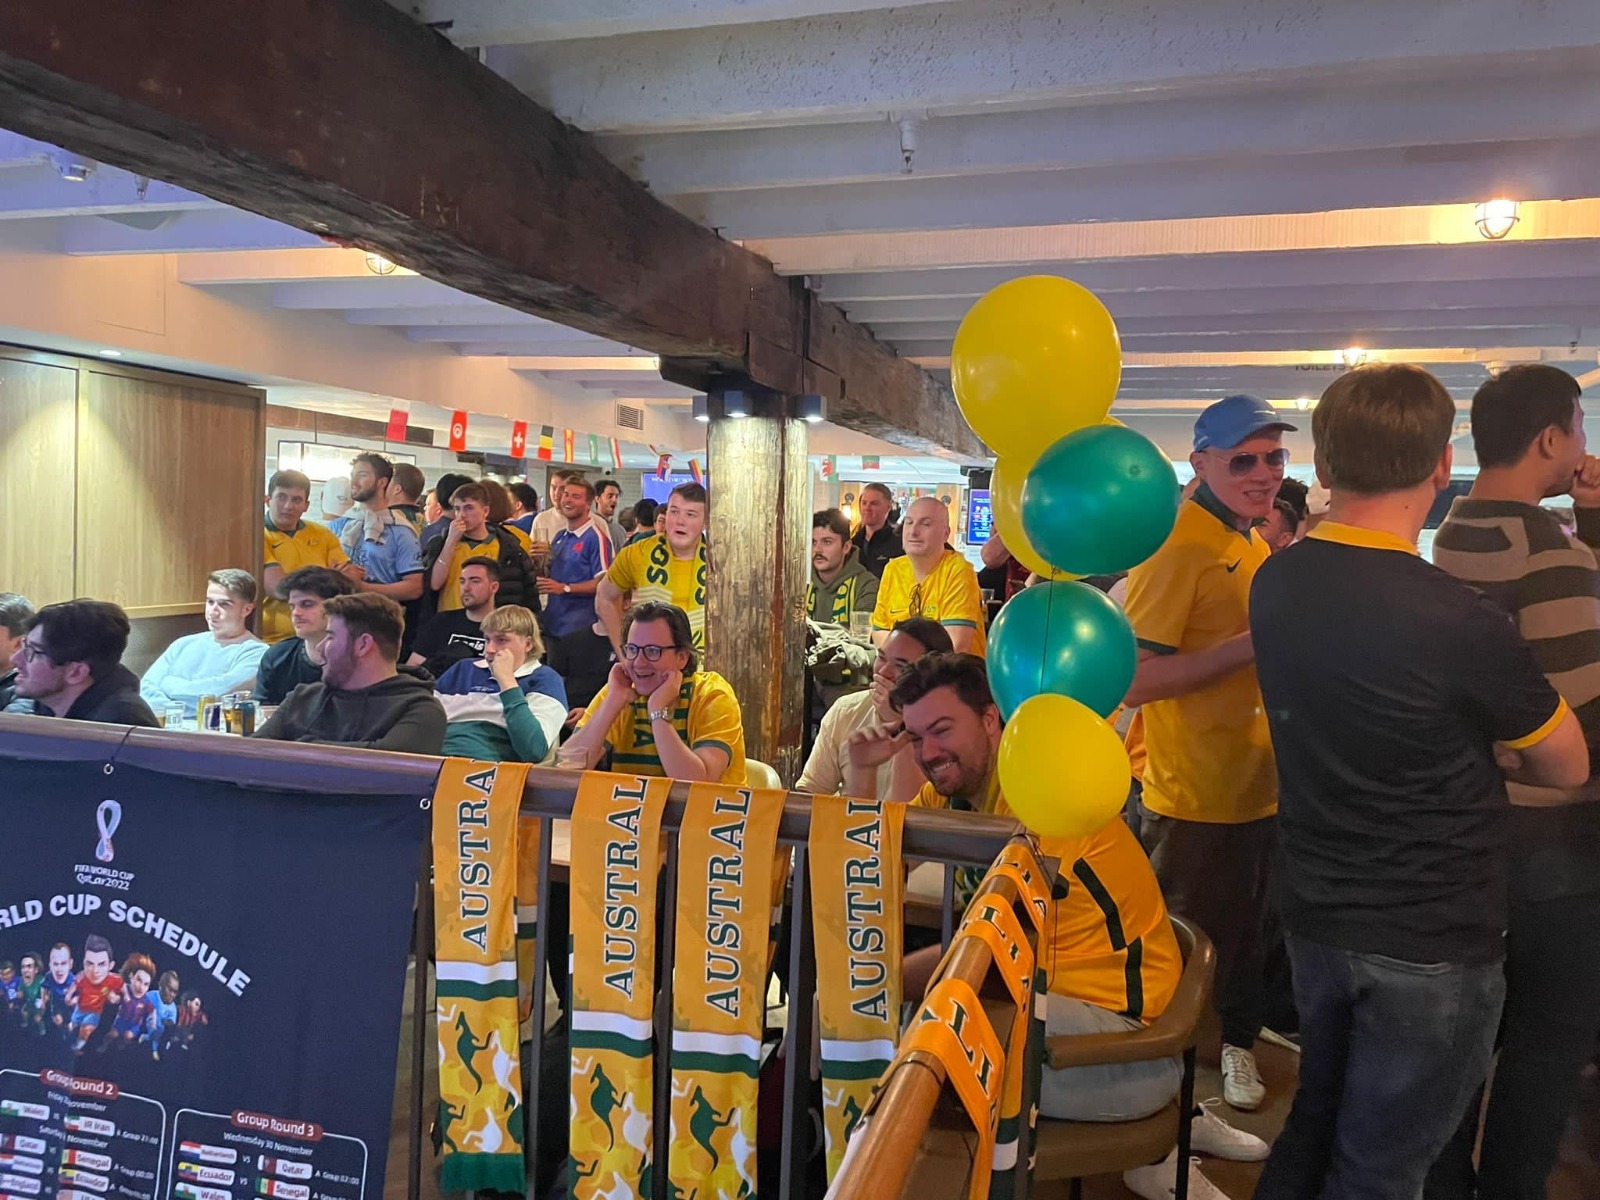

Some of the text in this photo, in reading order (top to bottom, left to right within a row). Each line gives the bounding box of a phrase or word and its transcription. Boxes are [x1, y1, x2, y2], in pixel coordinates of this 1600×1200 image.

[458, 760, 499, 956] AUSTRA
[91, 866, 118, 878] WORLD
[119, 871, 136, 881] CUP
[604, 776, 651, 1002] AUSTRAL
[705, 788, 754, 1020] AUSTRAL
[50, 893, 101, 917] CUP
[108, 899, 252, 997] SCHEDULE
[105, 1083, 114, 1095] 2
[237, 1112, 314, 1137] Group Round 3
[223, 1131, 265, 1149] Wednesday
[274, 1142, 313, 1157] November
[200, 1169, 233, 1181] Ecuador
[275, 1184, 308, 1198] Senegal
[281, 1163, 305, 1175] Qatar
[314, 1169, 321, 1177] A
